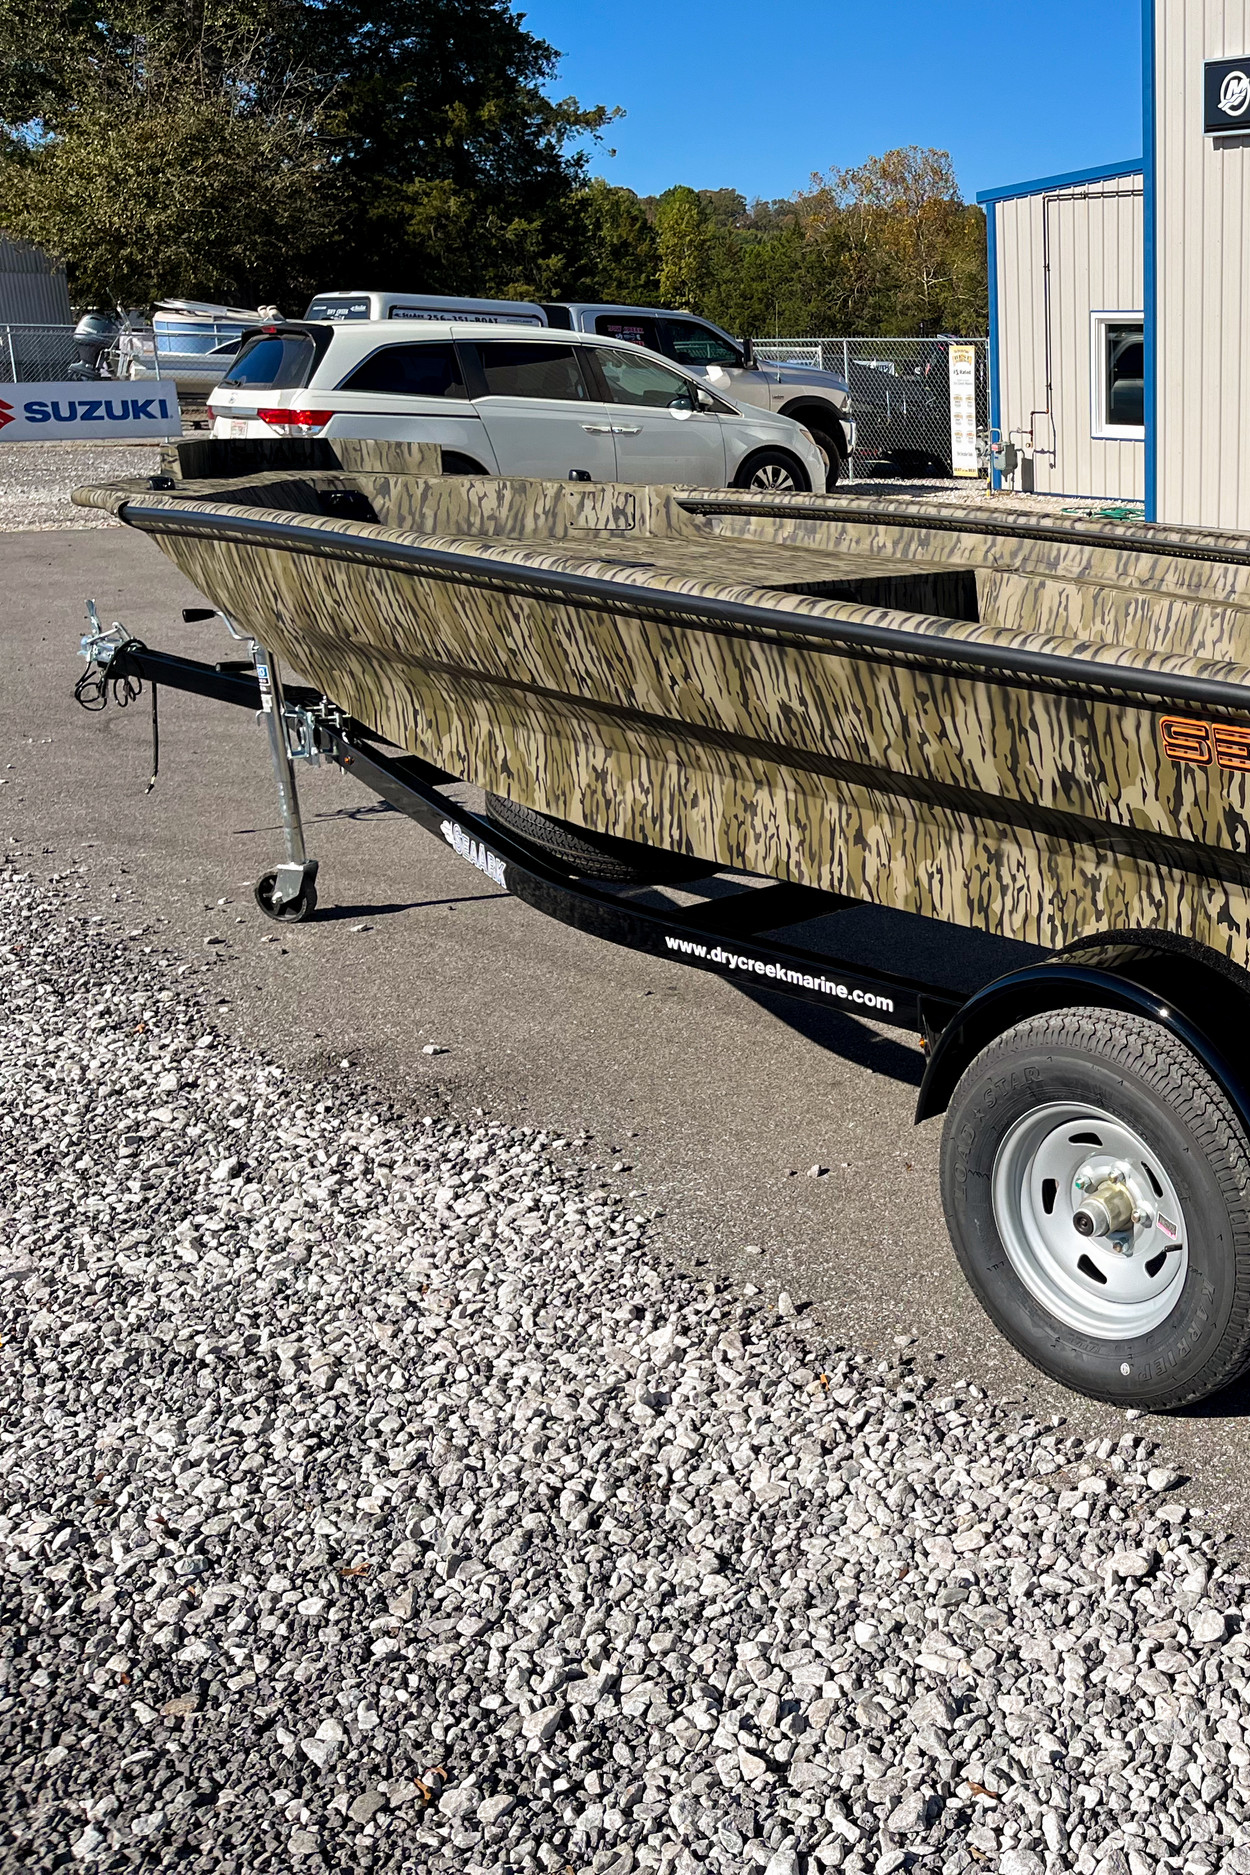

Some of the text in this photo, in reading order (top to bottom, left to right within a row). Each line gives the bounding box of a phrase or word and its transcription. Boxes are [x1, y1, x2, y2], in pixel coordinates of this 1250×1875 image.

[23, 399, 169, 423] SUZUKI
[665, 936, 894, 1013] www.drycreekmarine.com
[954, 1066, 1044, 1202] LOAD STAR
[1137, 1277, 1216, 1383] KARRIER
